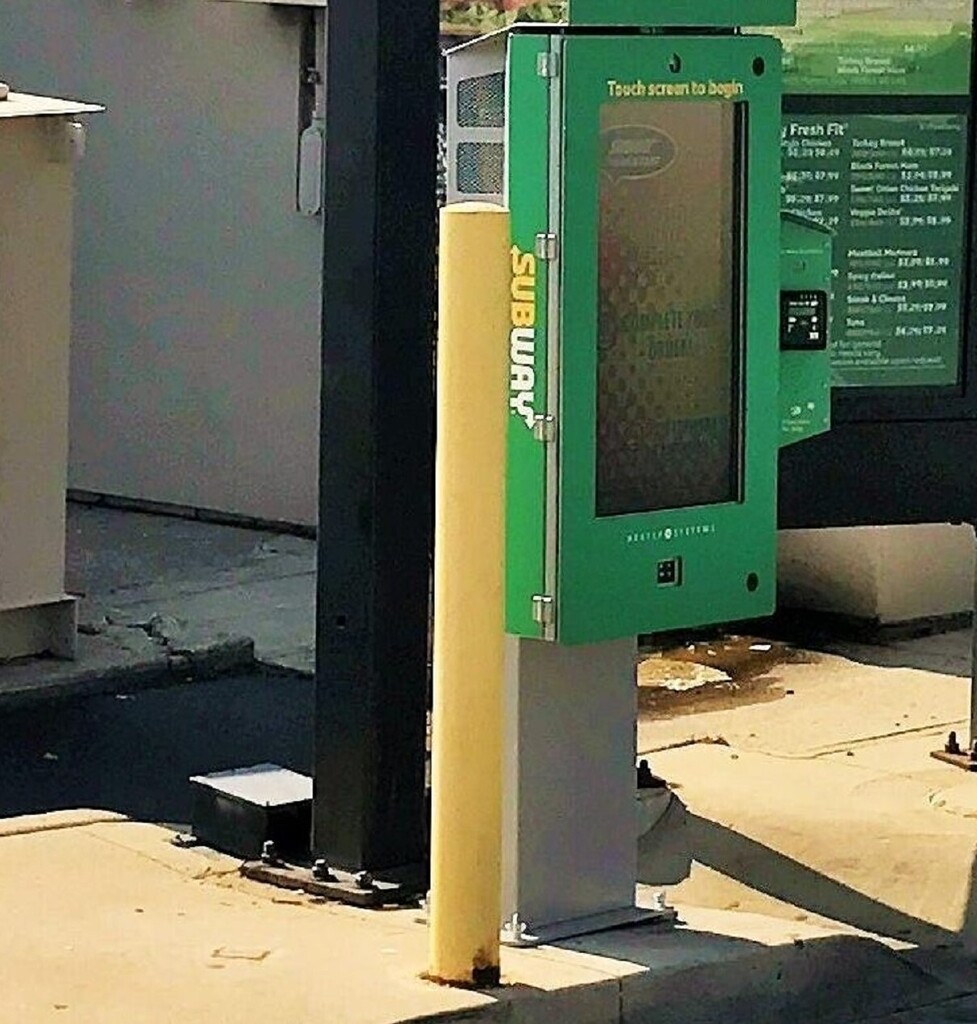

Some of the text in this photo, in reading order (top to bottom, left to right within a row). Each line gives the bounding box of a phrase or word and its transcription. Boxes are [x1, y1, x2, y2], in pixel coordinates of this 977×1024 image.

[607, 80, 744, 98] Touch screen to begin
[790, 123, 824, 136] Fresh
[509, 244, 537, 430] SUBWAY
